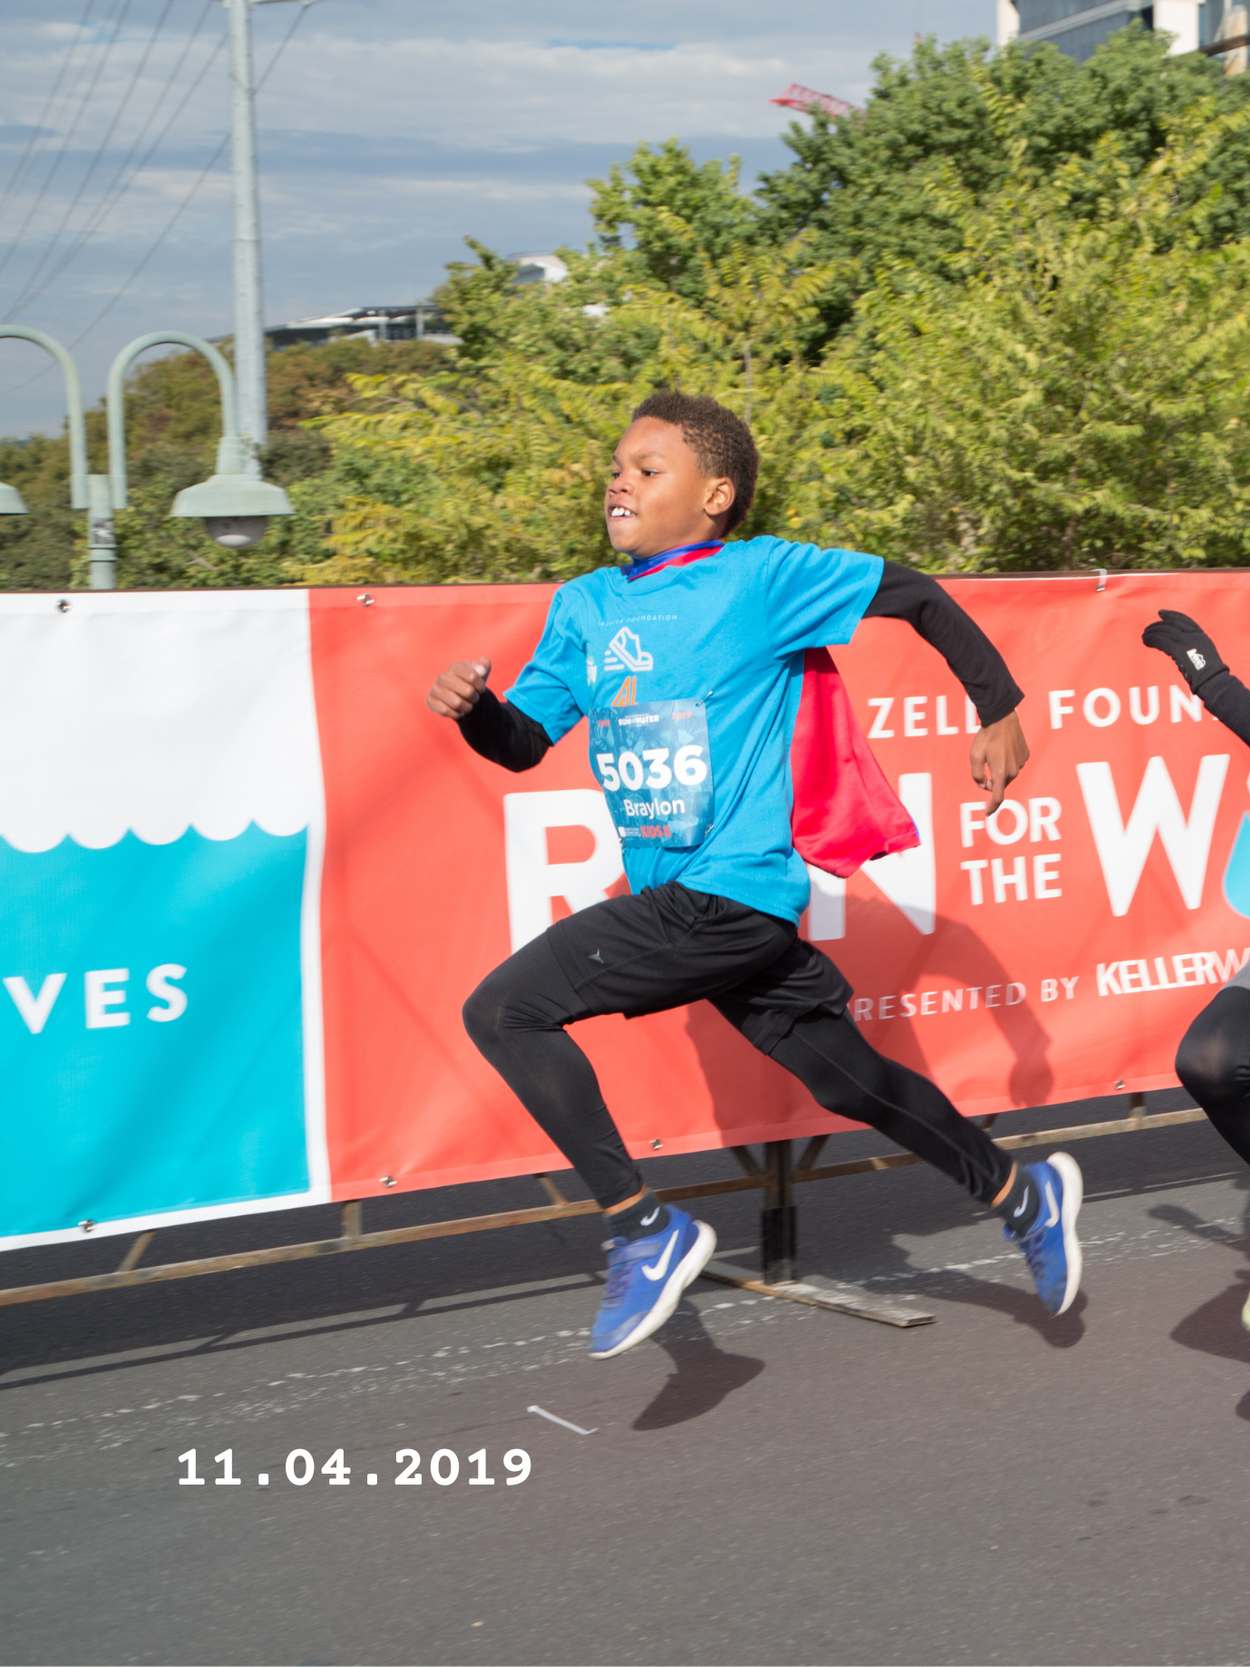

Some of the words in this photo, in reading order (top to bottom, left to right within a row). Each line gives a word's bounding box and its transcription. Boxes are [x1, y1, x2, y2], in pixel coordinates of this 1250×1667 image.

[671, 711, 692, 721] 2019
[867, 694, 982, 739] ZELL
[596, 744, 708, 792] 5036
[623, 797, 686, 820] Braylon
[640, 824, 663, 838] KIDS
[663, 824, 673, 838] K
[960, 796, 1063, 848] FOR
[960, 853, 1063, 906] THE
[847, 982, 1027, 1022] RESENTED
[1040, 975, 1080, 1003] BY
